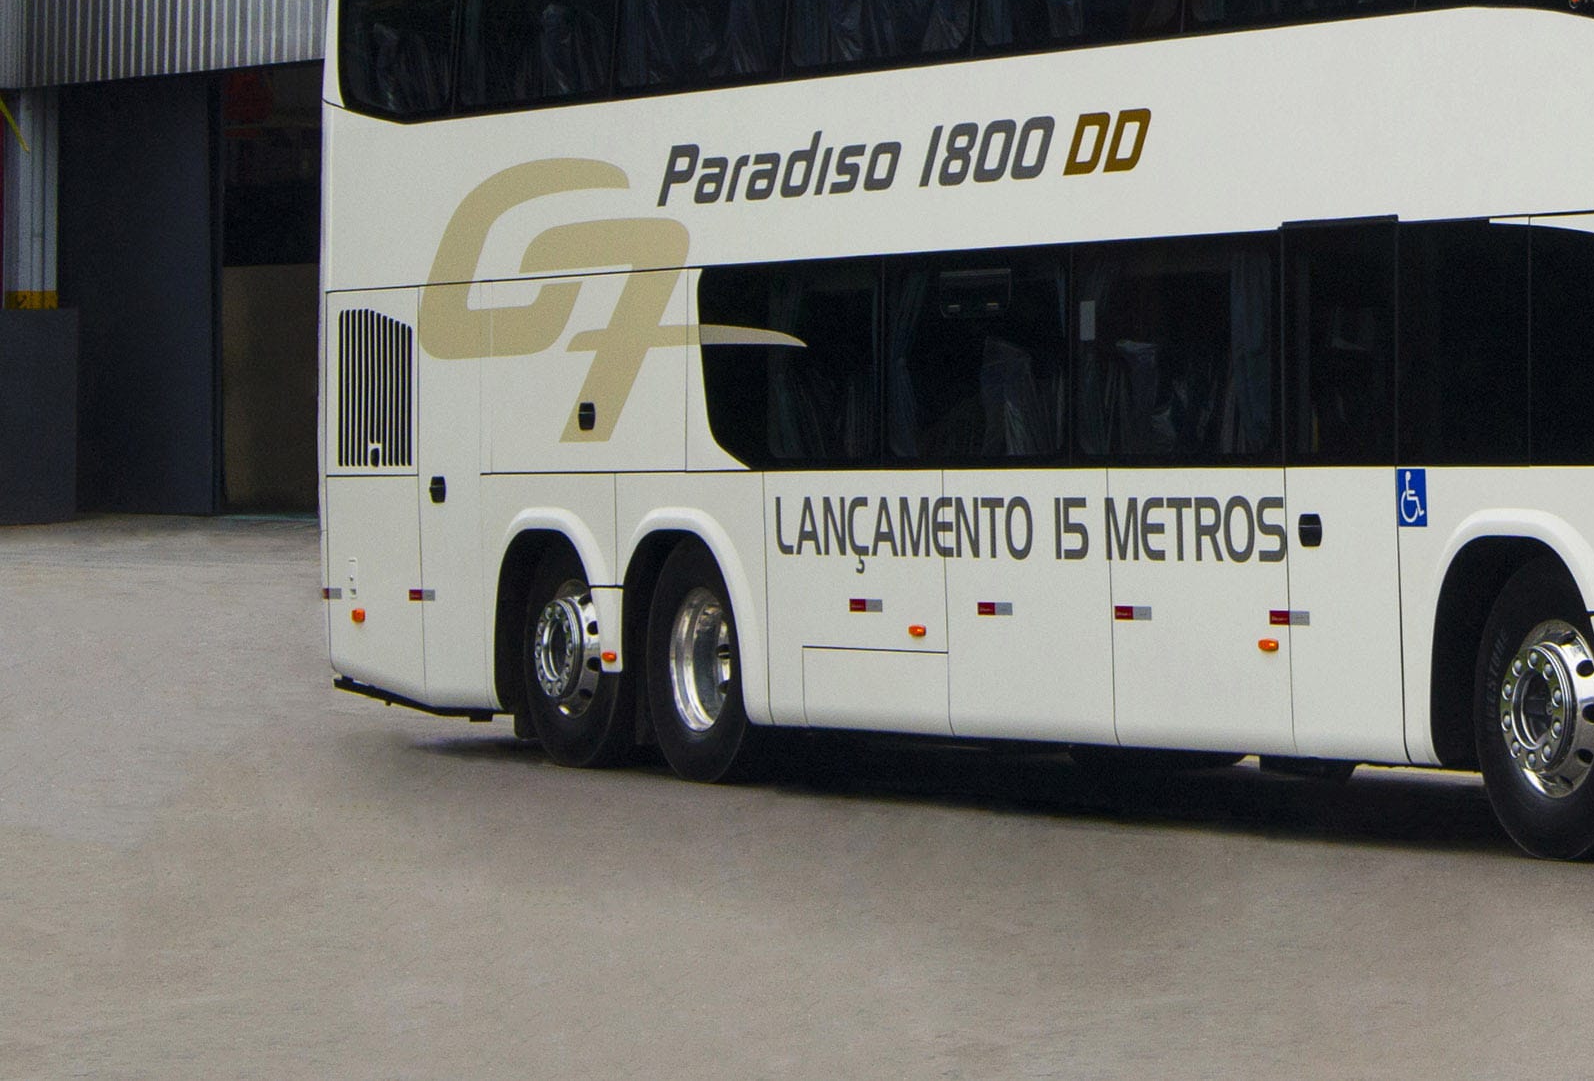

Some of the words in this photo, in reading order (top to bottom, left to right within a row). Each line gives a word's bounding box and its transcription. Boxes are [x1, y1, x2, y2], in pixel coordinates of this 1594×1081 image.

[657, 130, 903, 208] Paradiso
[918, 116, 1056, 189] 1800
[1062, 107, 1153, 176] DD
[774, 496, 1034, 575] LANÇAMENTO
[1053, 496, 1090, 561] 15
[1104, 495, 1287, 564] METROS
